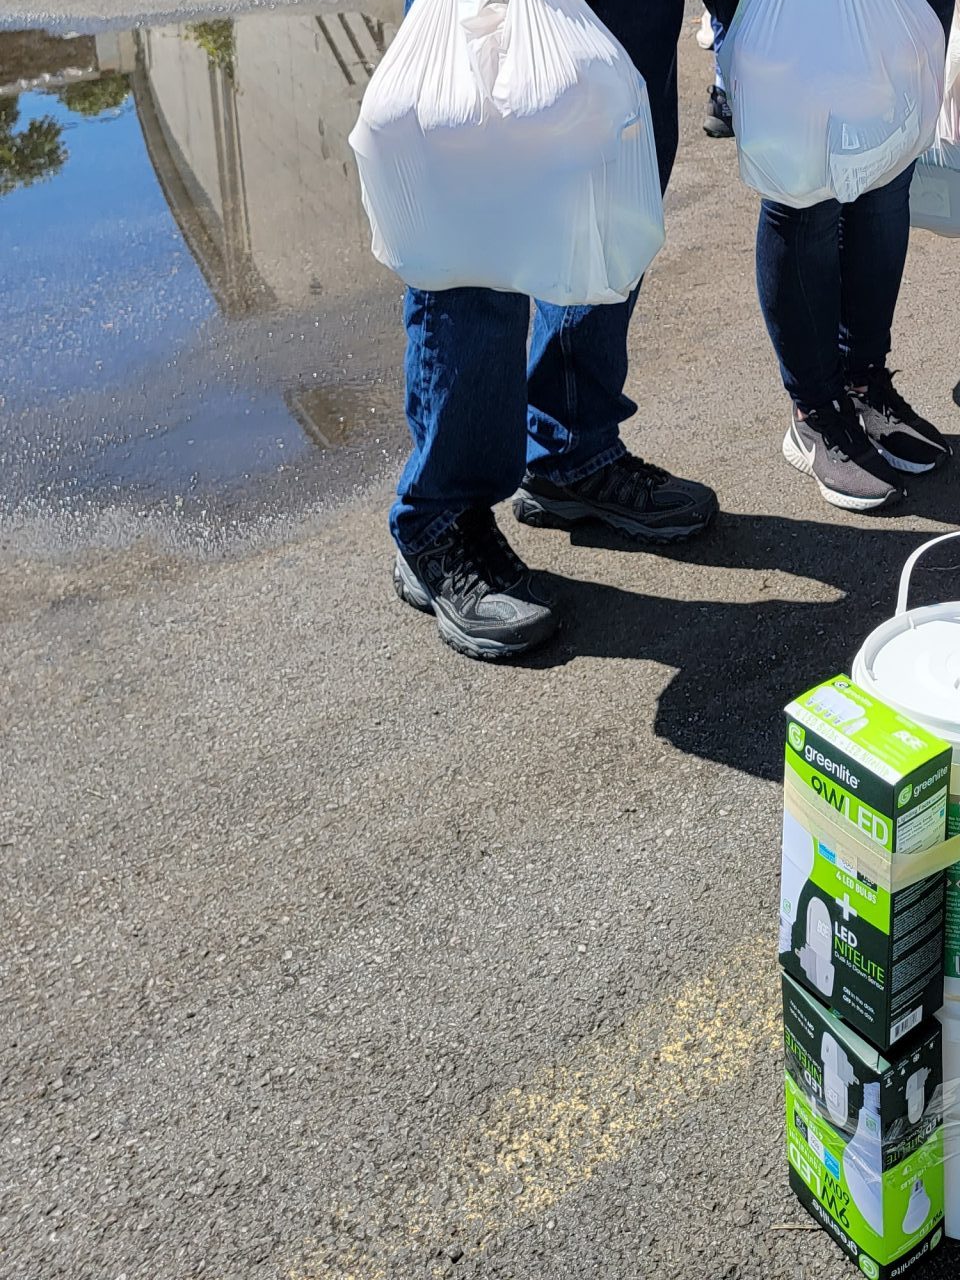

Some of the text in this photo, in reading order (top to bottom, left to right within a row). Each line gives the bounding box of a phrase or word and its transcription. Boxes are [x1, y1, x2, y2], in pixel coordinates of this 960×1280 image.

[804, 744, 859, 790] greenlite
[913, 766, 949, 797] greenlite
[836, 871, 841, 881] 4
[842, 875, 854, 890] LED
[855, 883, 877, 904] BULBS
[835, 921, 858, 947] LED
[834, 936, 885, 984] NITELITE
[784, 1030, 822, 1084] NITELITE
[804, 1070, 822, 1098] LED
[824, 1170, 850, 1204] 60W
[812, 1198, 858, 1256] greenlite
[891, 1241, 928, 1277] greenlite
